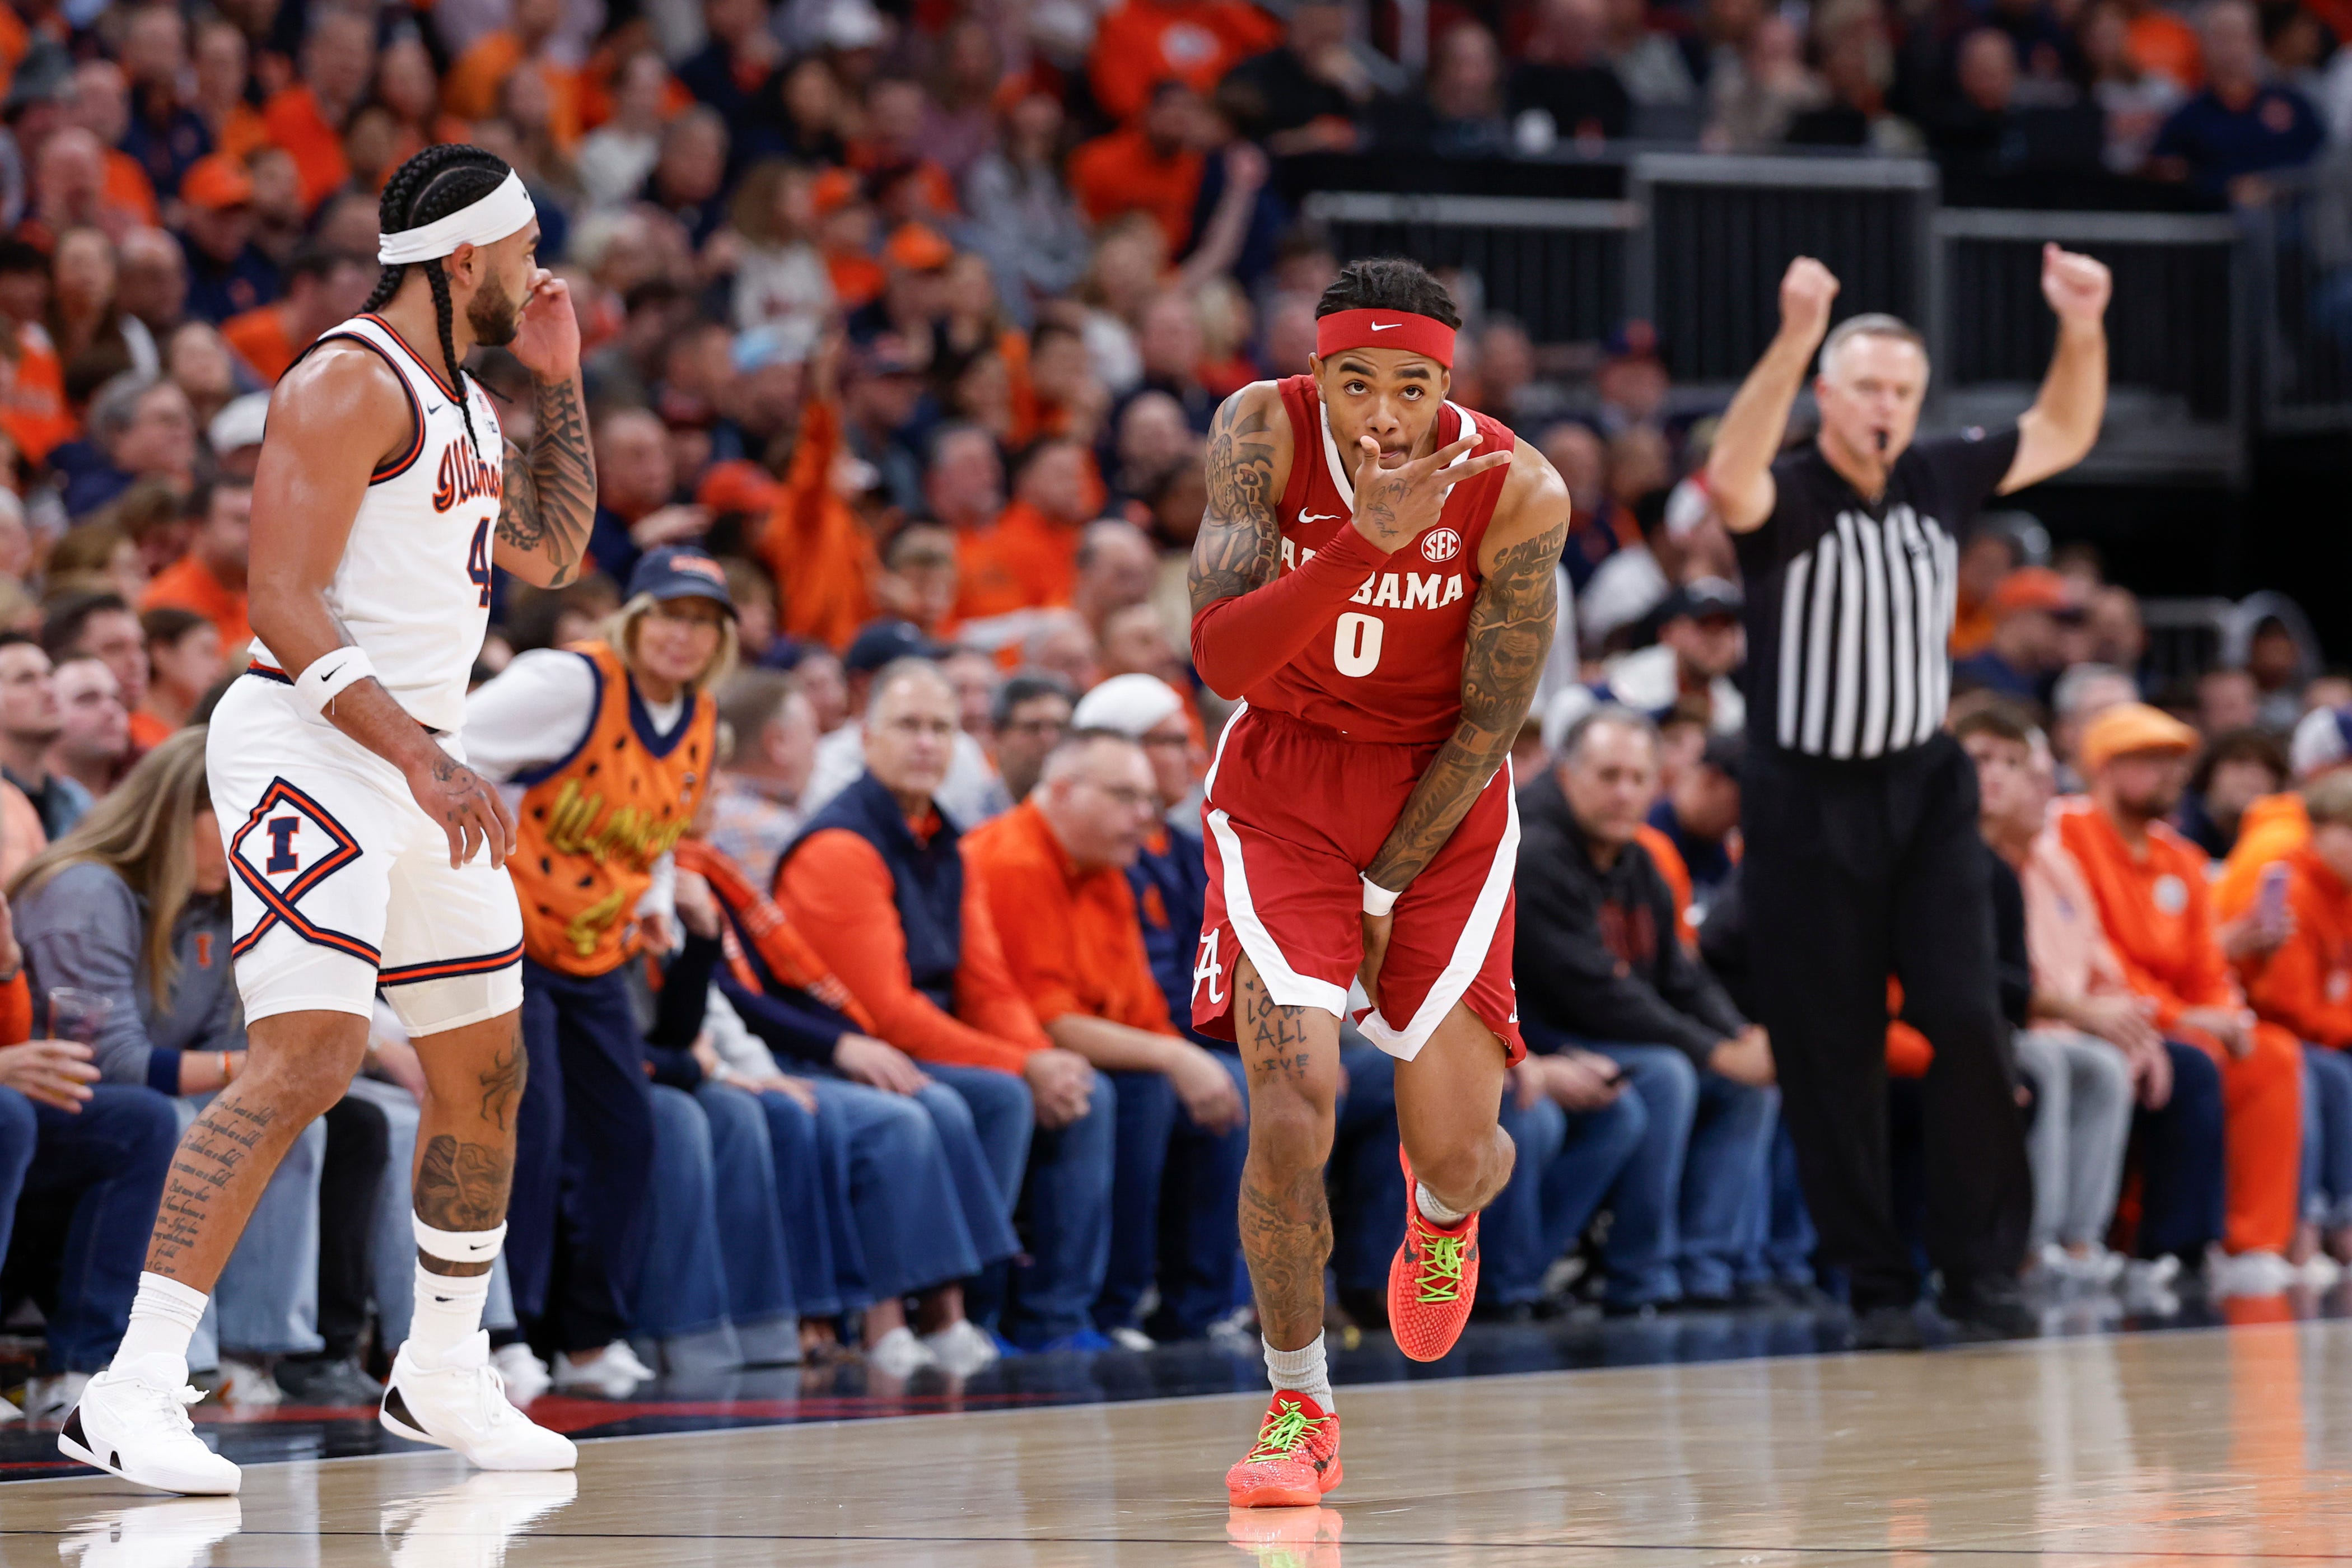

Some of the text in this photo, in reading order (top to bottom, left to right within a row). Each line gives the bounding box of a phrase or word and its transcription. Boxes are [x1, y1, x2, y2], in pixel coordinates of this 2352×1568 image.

[466, 516, 492, 608] 4
[1281, 535, 1464, 610] ABAMA
[1425, 531, 1457, 560] SEC
[1334, 612, 1384, 678] 0
[267, 816, 300, 875] I
[1191, 927, 1224, 1010] A
[1253, 1054, 1309, 1072] LIVE
[1254, 1019, 1306, 1051] ALL
